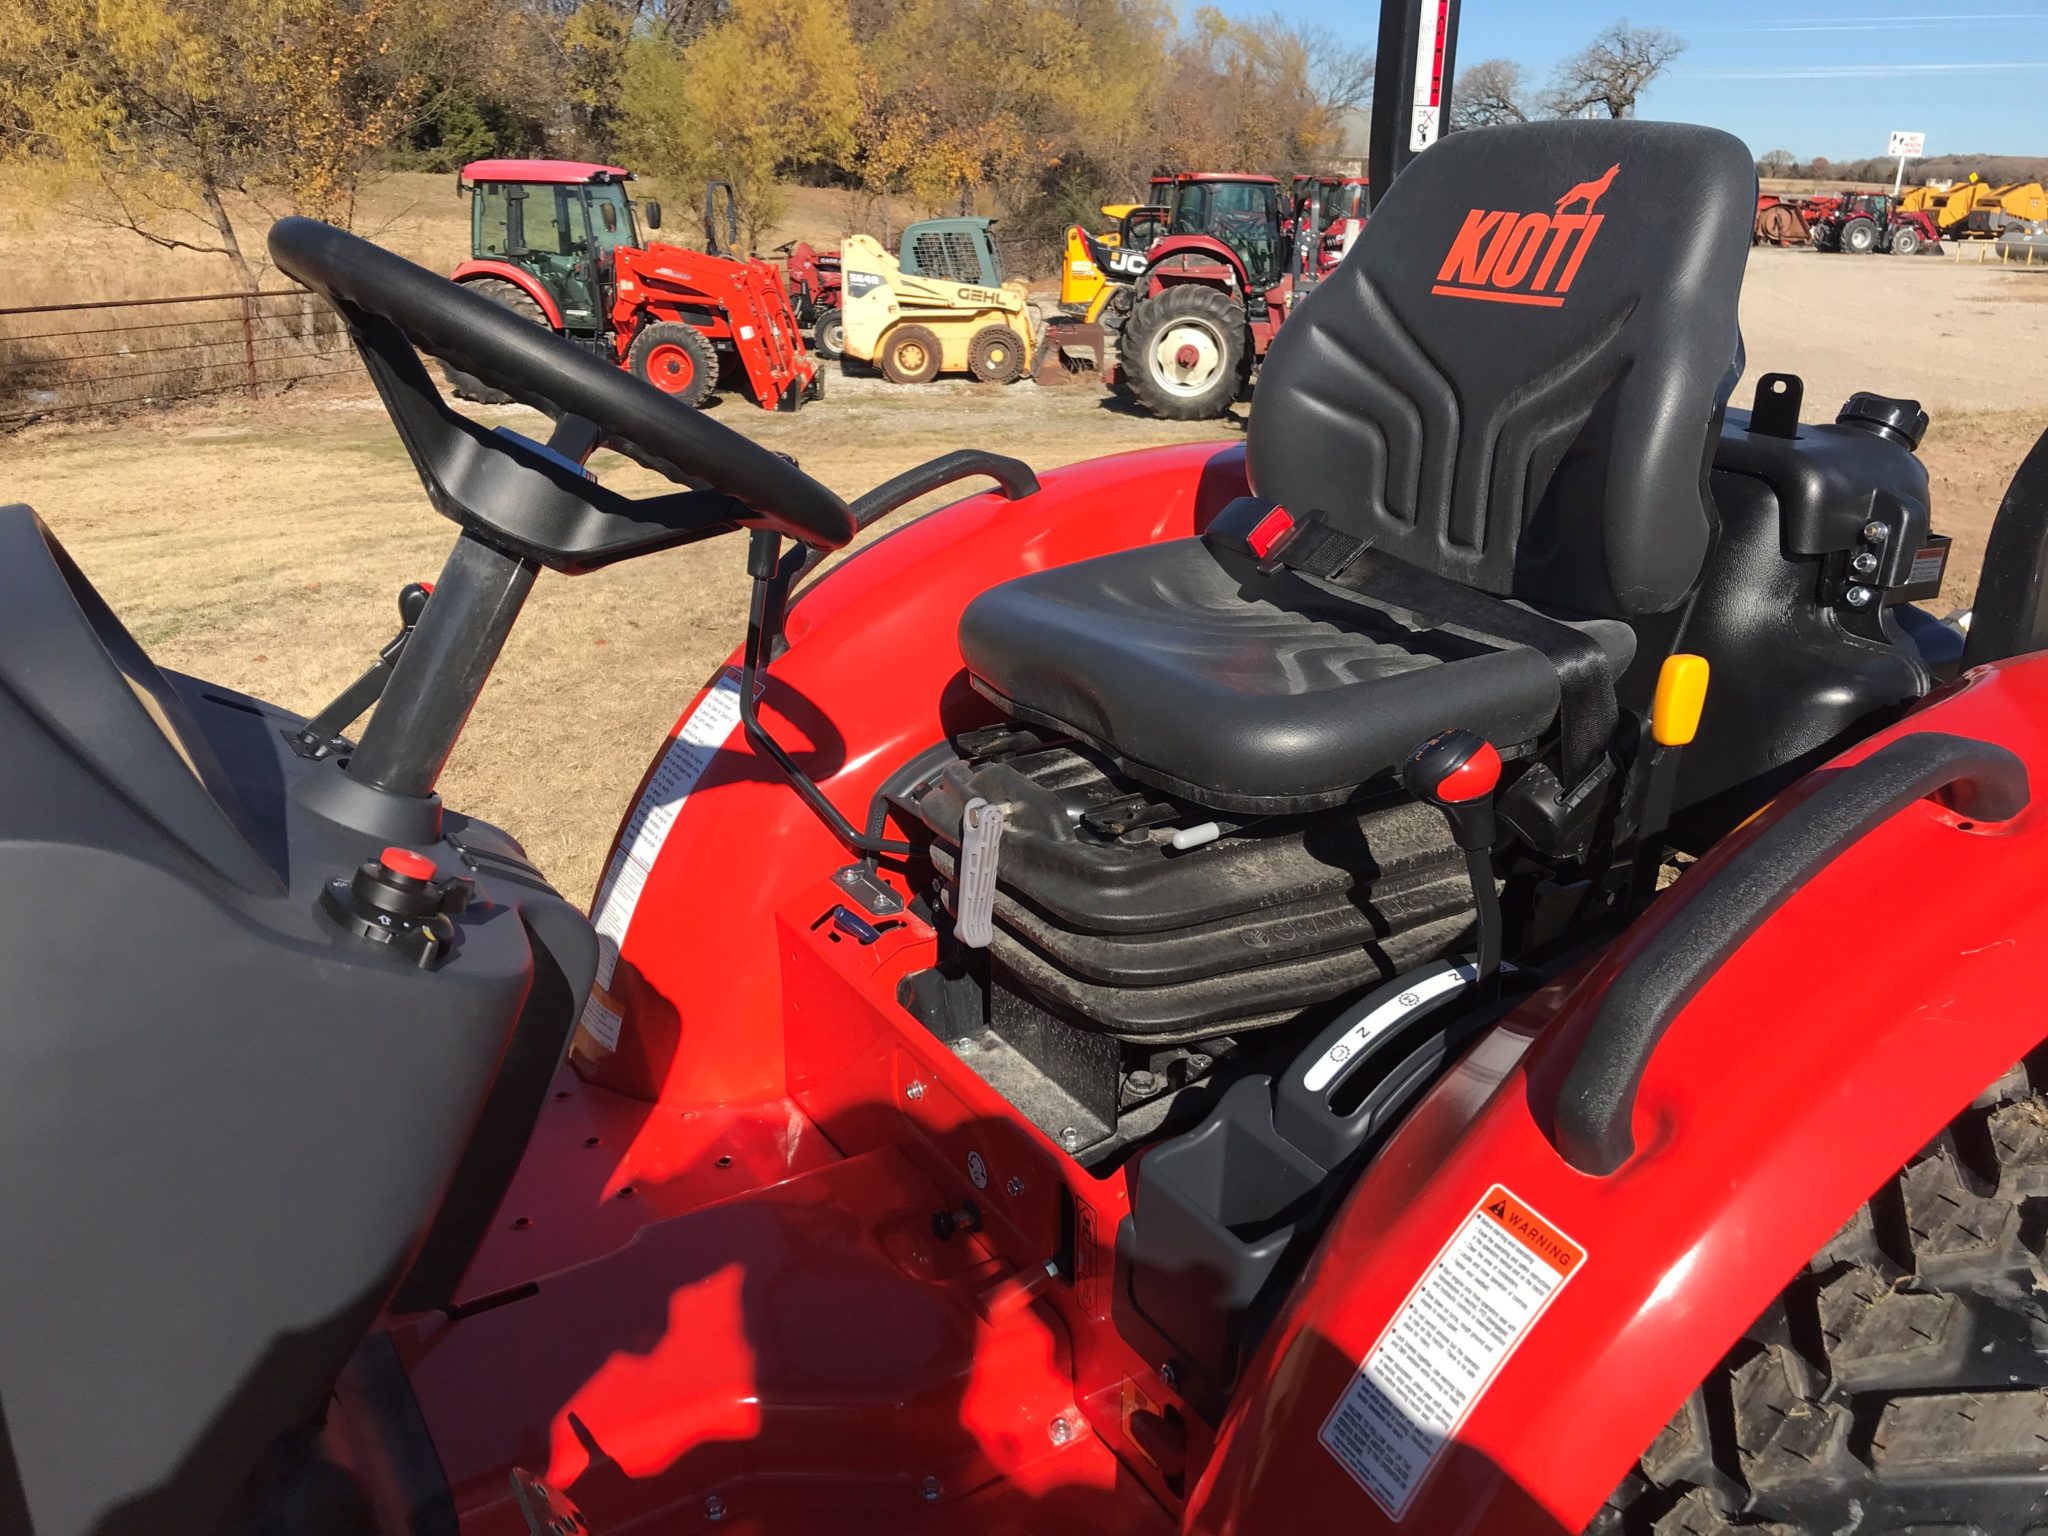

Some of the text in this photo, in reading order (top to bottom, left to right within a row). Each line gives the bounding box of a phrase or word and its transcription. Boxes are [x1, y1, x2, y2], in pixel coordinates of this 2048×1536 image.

[1432, 0, 1447, 94] GER
[1110, 253, 1148, 274] JC
[1436, 209, 1604, 293] KIOTI
[957, 287, 1006, 306] GEHL
[1508, 1211, 1570, 1266] WARNING
